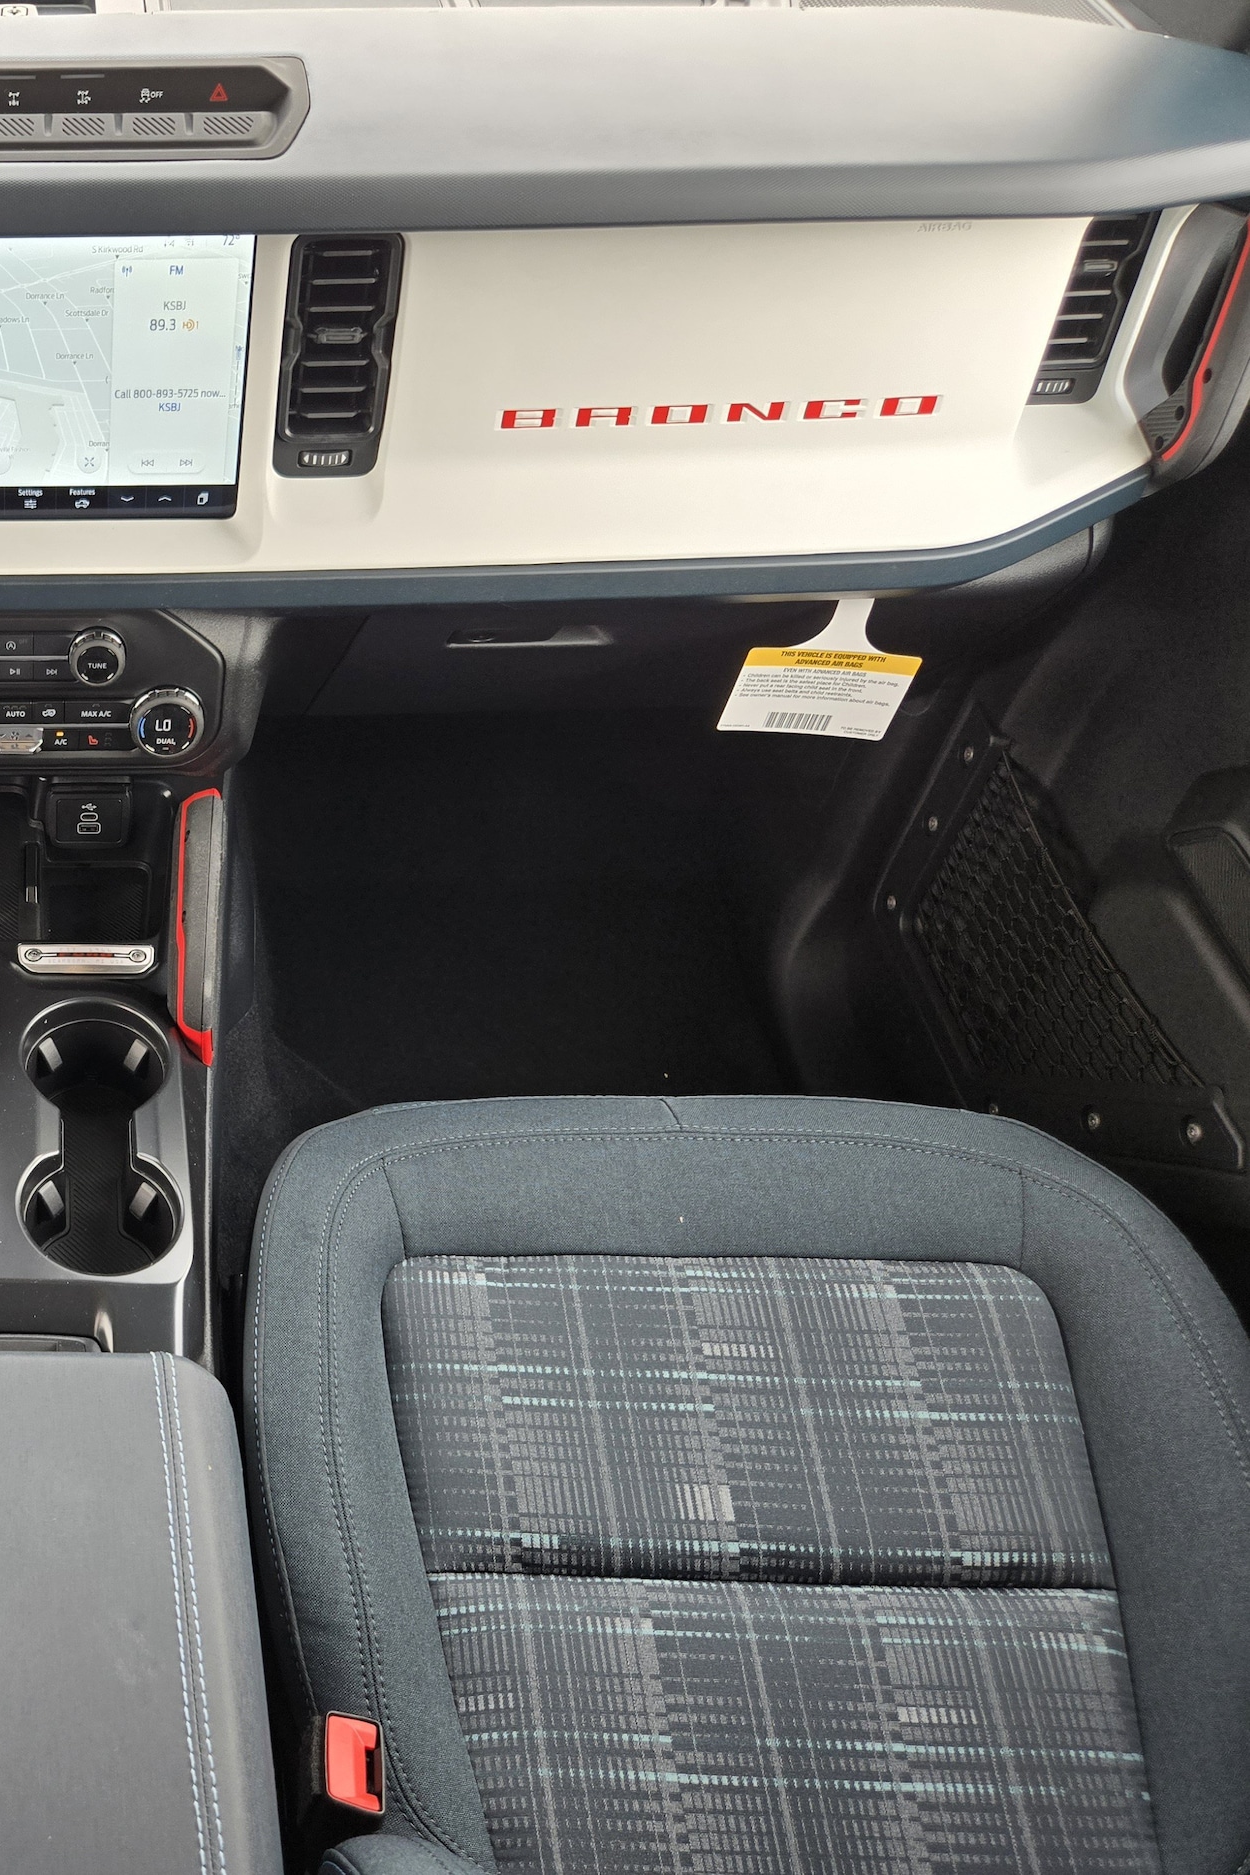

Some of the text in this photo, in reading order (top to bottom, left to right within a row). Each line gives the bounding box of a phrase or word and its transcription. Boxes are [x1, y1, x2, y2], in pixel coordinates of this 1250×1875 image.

[917, 222, 972, 233] AIRBAG
[170, 265, 183, 275] FM
[163, 301, 186, 310] KSBJ
[150, 319, 176, 331] 89.3
[115, 390, 131, 399] Call
[133, 389, 198, 398] 800-893-5725
[158, 403, 181, 412] KSBJ
[499, 395, 940, 430] BRONCO
[18, 489, 43, 497] Settings
[69, 488, 95, 496] Features
[155, 719, 172, 732] LO
